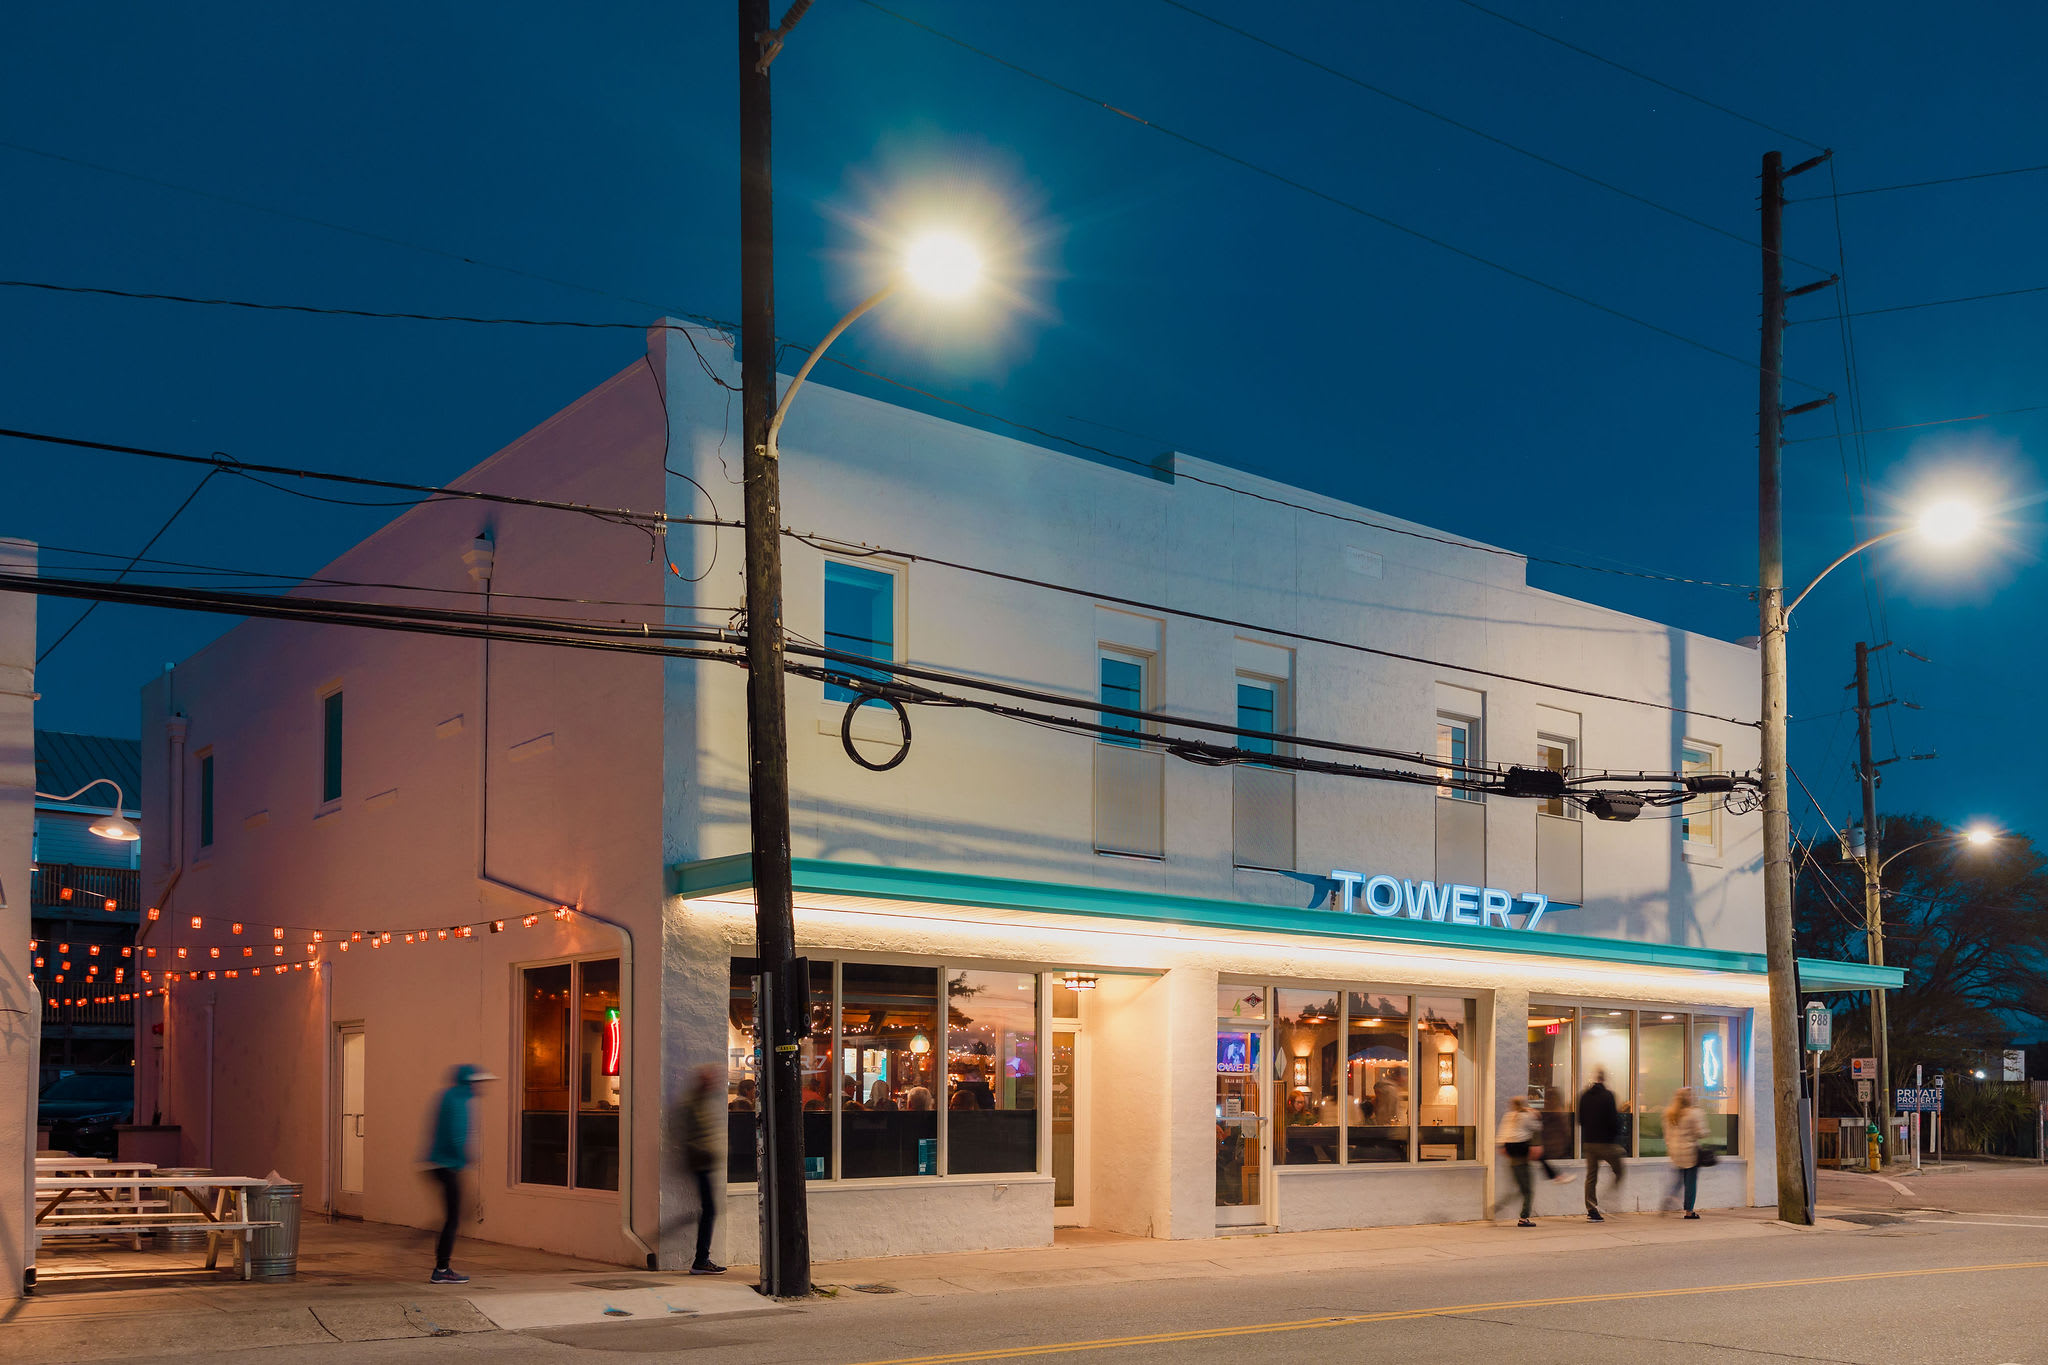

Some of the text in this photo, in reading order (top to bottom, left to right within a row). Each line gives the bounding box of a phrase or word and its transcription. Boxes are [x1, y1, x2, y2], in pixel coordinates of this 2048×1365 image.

[1331, 869, 1548, 931] TOWER 7
[1811, 1014, 1828, 1026] 988
[730, 1054, 828, 1069] TOR 7
[1062, 1064, 1069, 1072] 7
[1217, 1062, 1259, 1072] OWER 7
[1897, 1089, 1943, 1098] PRIVATE
[1897, 1096, 1943, 1104] PROERT
